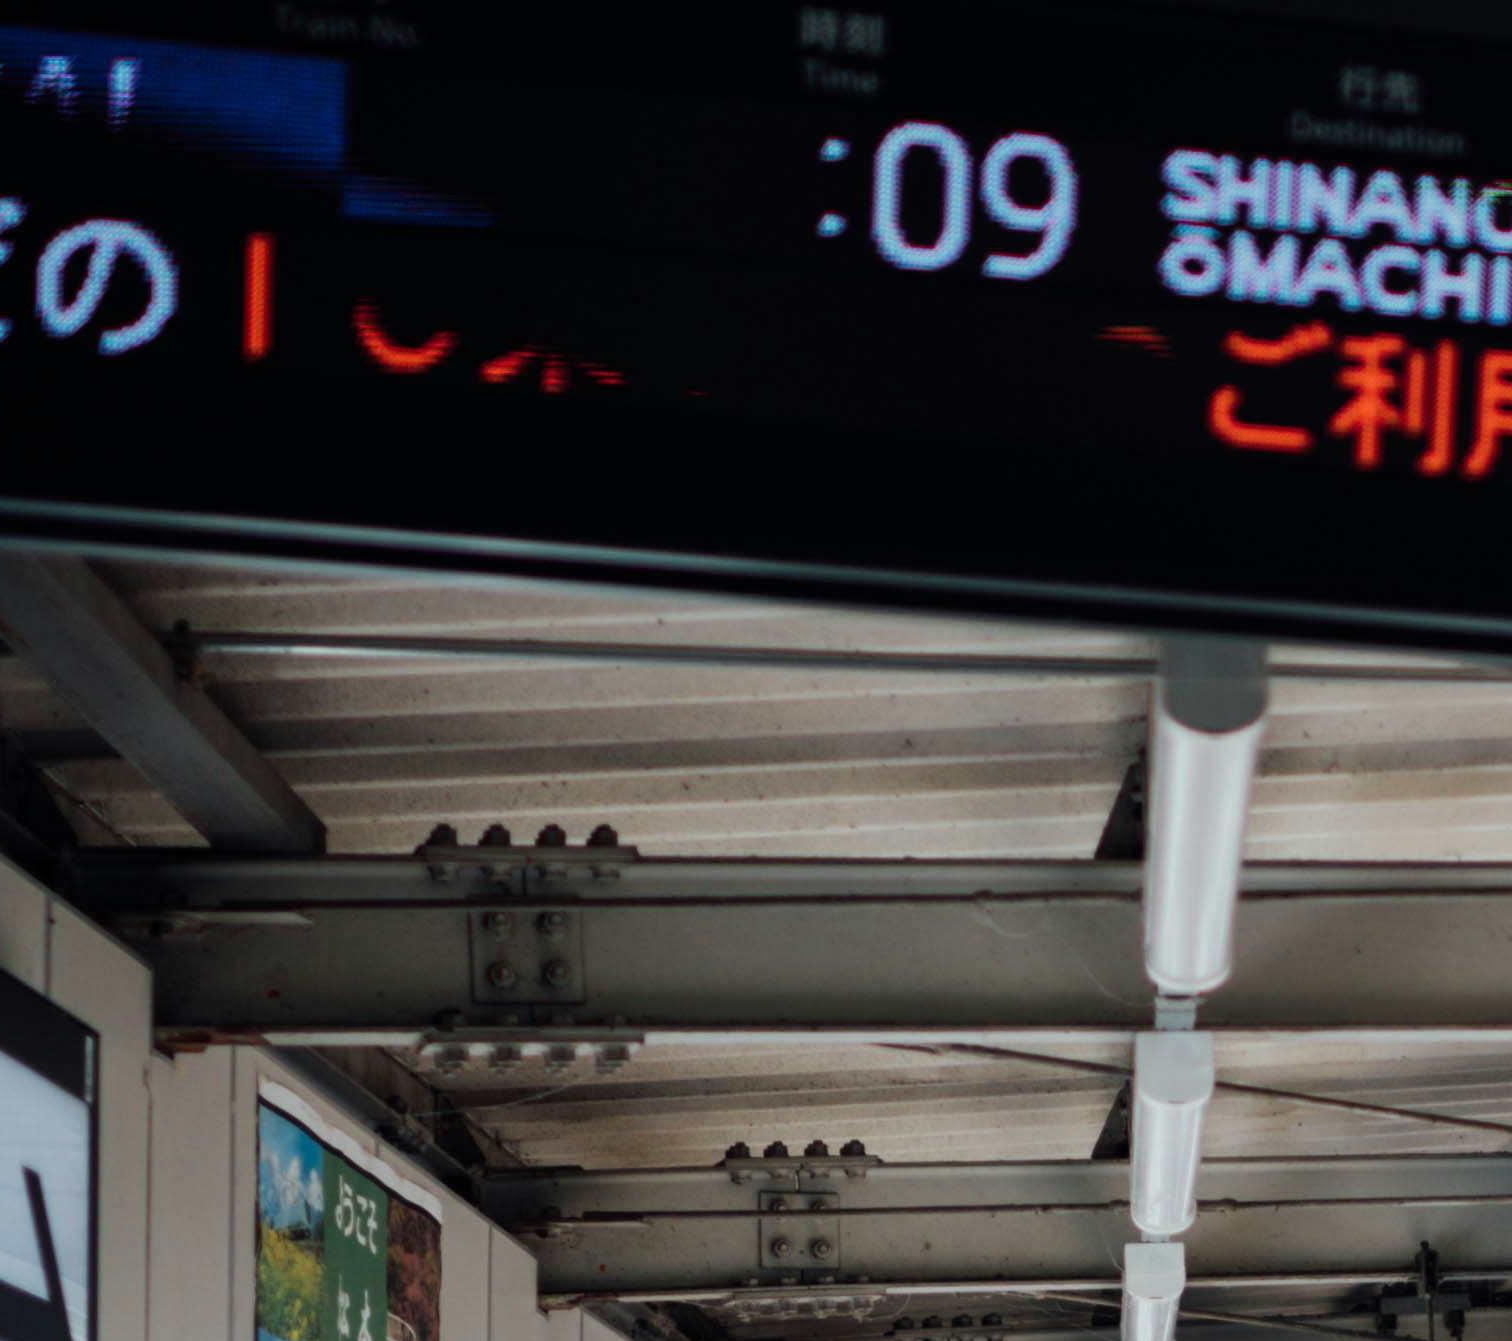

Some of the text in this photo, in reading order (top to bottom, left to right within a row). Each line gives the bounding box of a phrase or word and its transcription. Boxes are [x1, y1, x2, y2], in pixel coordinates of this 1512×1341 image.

[798, 58, 882, 98] Time
[1338, 62, 1423, 115] 行先
[1288, 108, 1470, 158] Destination
